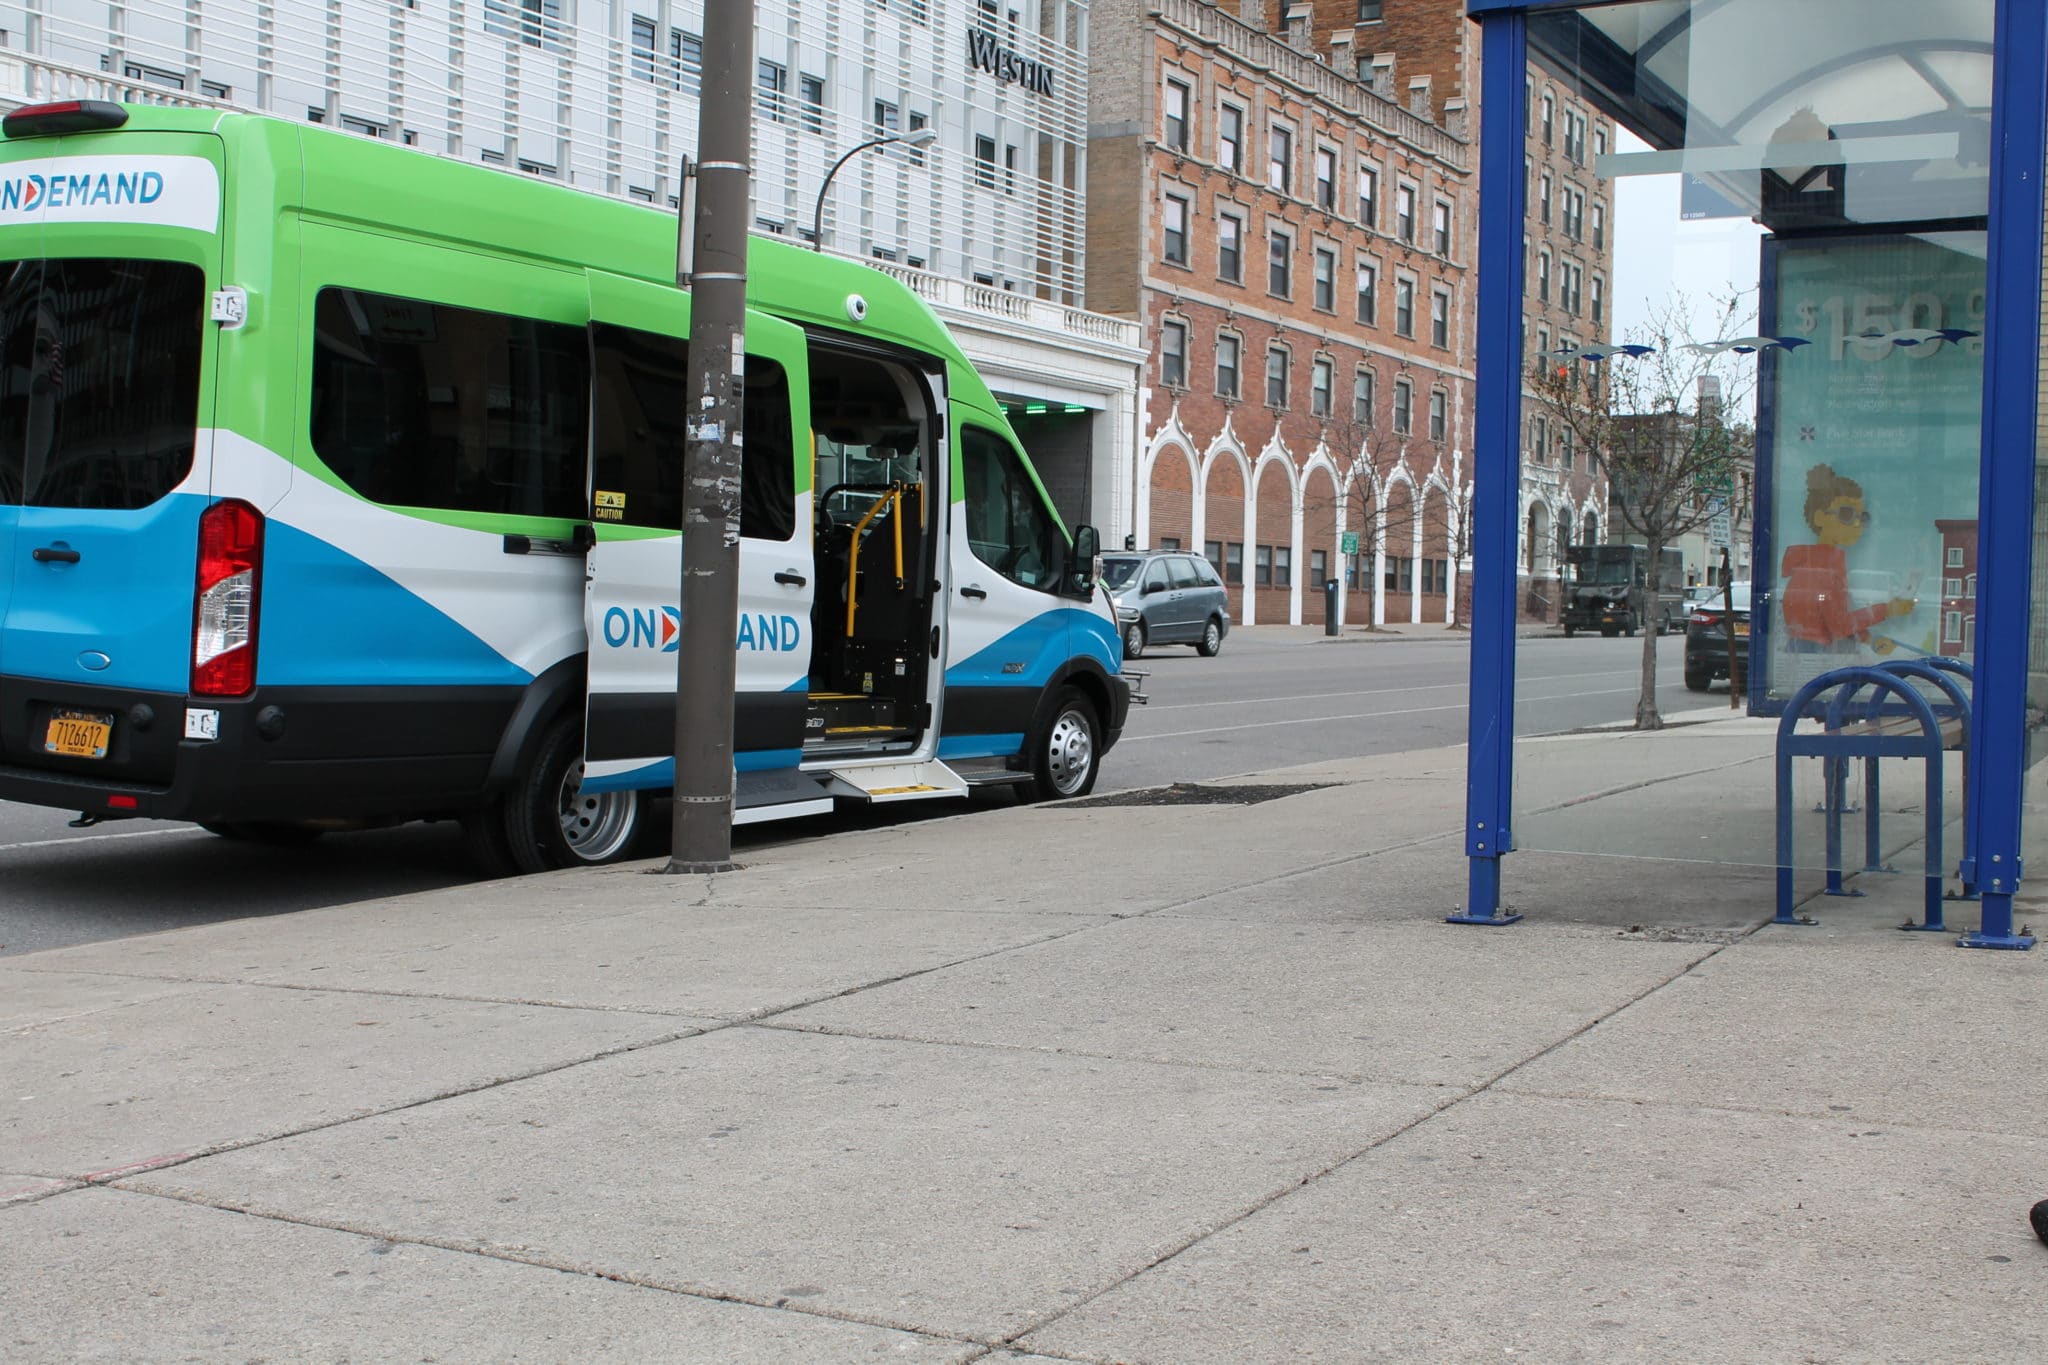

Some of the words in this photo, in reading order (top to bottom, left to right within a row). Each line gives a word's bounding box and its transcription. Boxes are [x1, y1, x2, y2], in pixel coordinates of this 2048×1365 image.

[968, 29, 1054, 97] WESTIN
[0, 171, 164, 212] NDEMAND
[595, 507, 623, 520] CAUTION
[56, 721, 102, 748] 7126612
